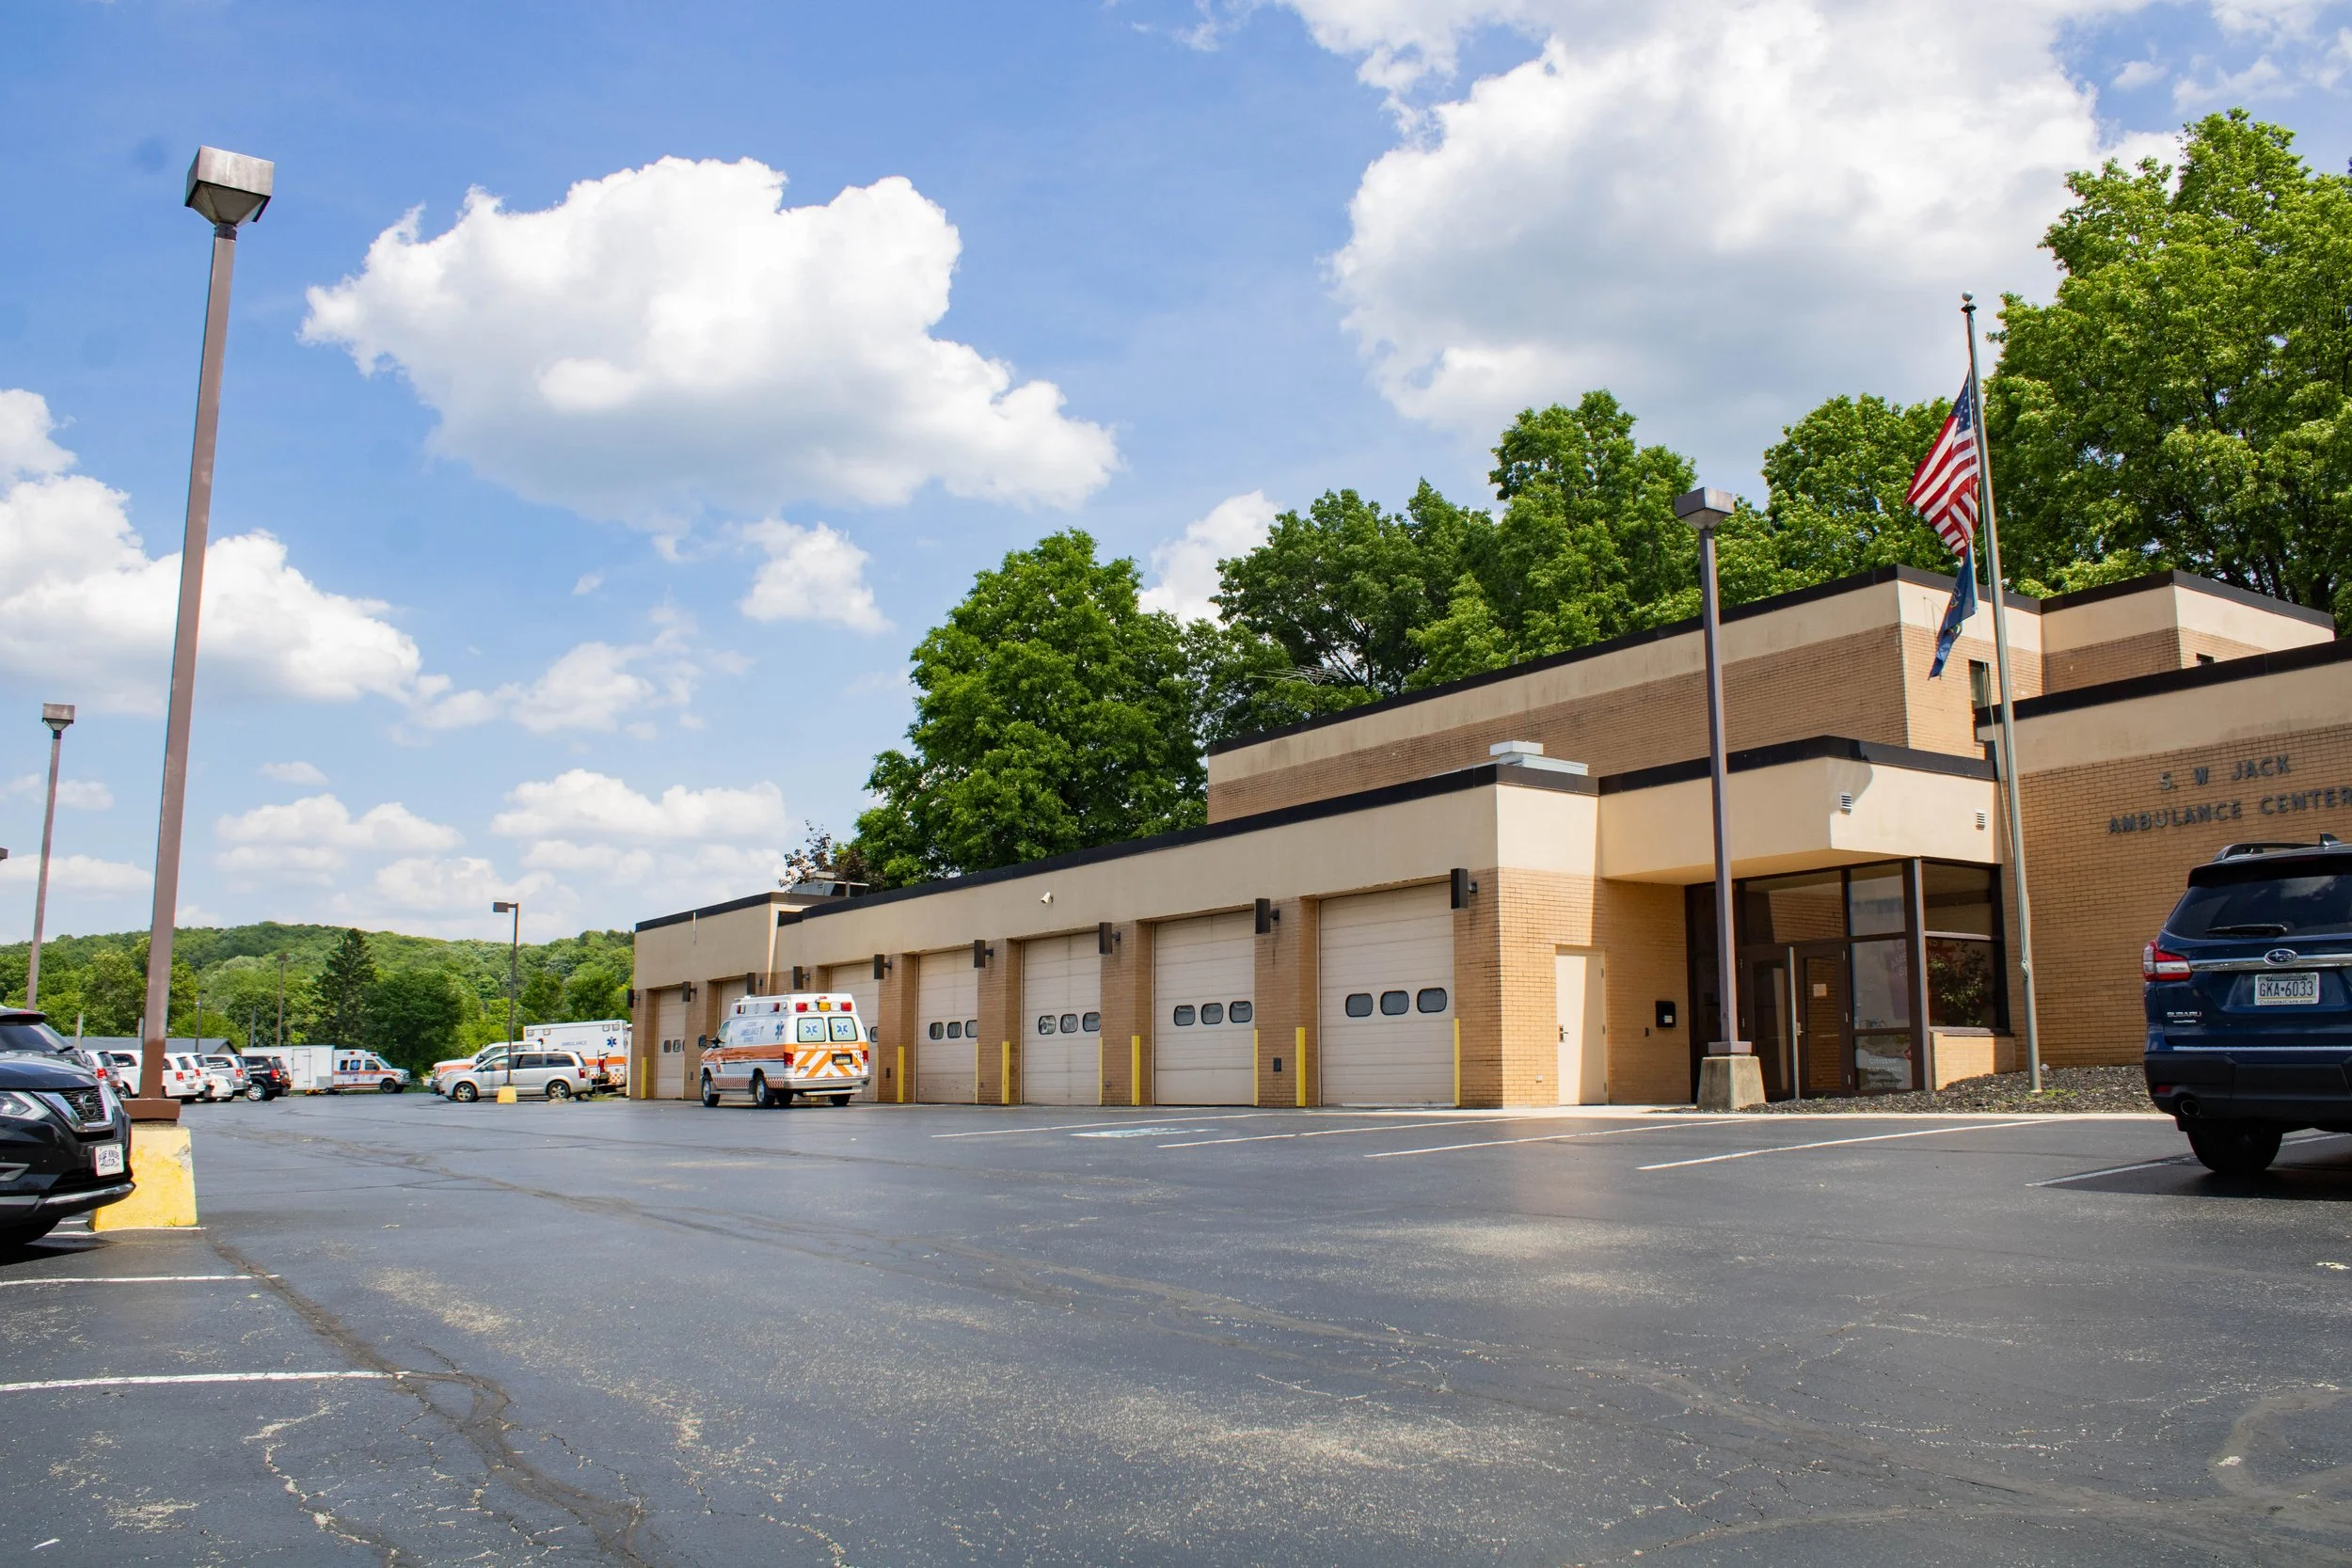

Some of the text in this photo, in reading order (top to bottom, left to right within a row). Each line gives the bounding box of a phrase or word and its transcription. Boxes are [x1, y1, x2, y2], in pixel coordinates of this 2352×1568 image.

[2232, 755, 2292, 781] JACK
[2108, 786, 2352, 834] AMBULANCE CENTER
